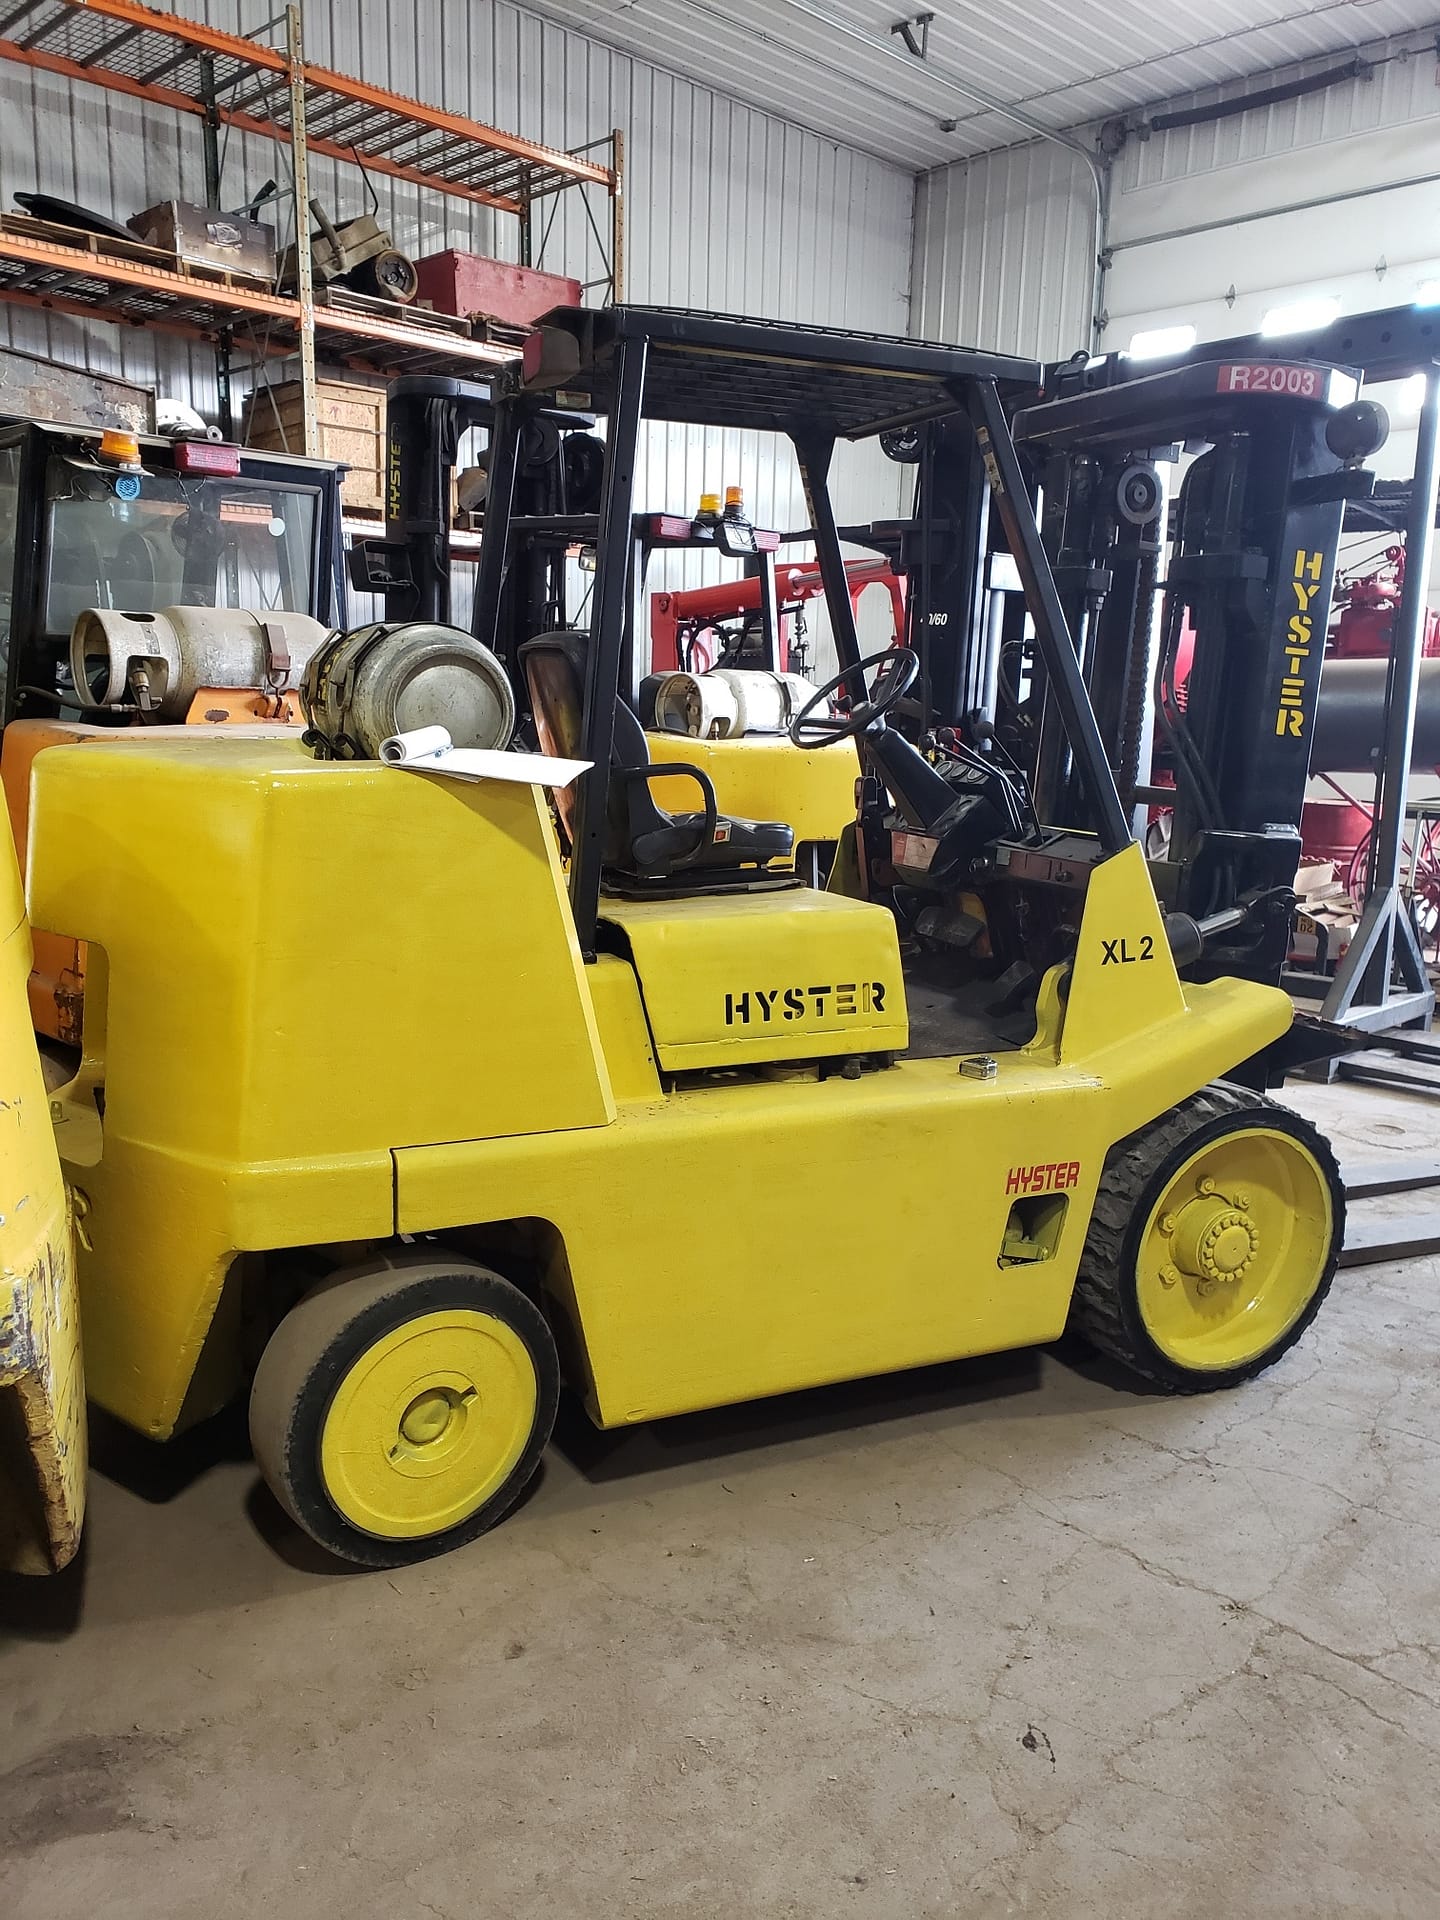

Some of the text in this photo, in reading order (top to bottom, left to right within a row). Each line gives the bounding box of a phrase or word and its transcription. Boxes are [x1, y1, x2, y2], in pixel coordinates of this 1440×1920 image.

[1228, 366, 1315, 395] R2003
[1276, 550, 1323, 736] HYSTER
[725, 982, 886, 1025] HYSTER
[1005, 1161, 1080, 1195] HYSTER
